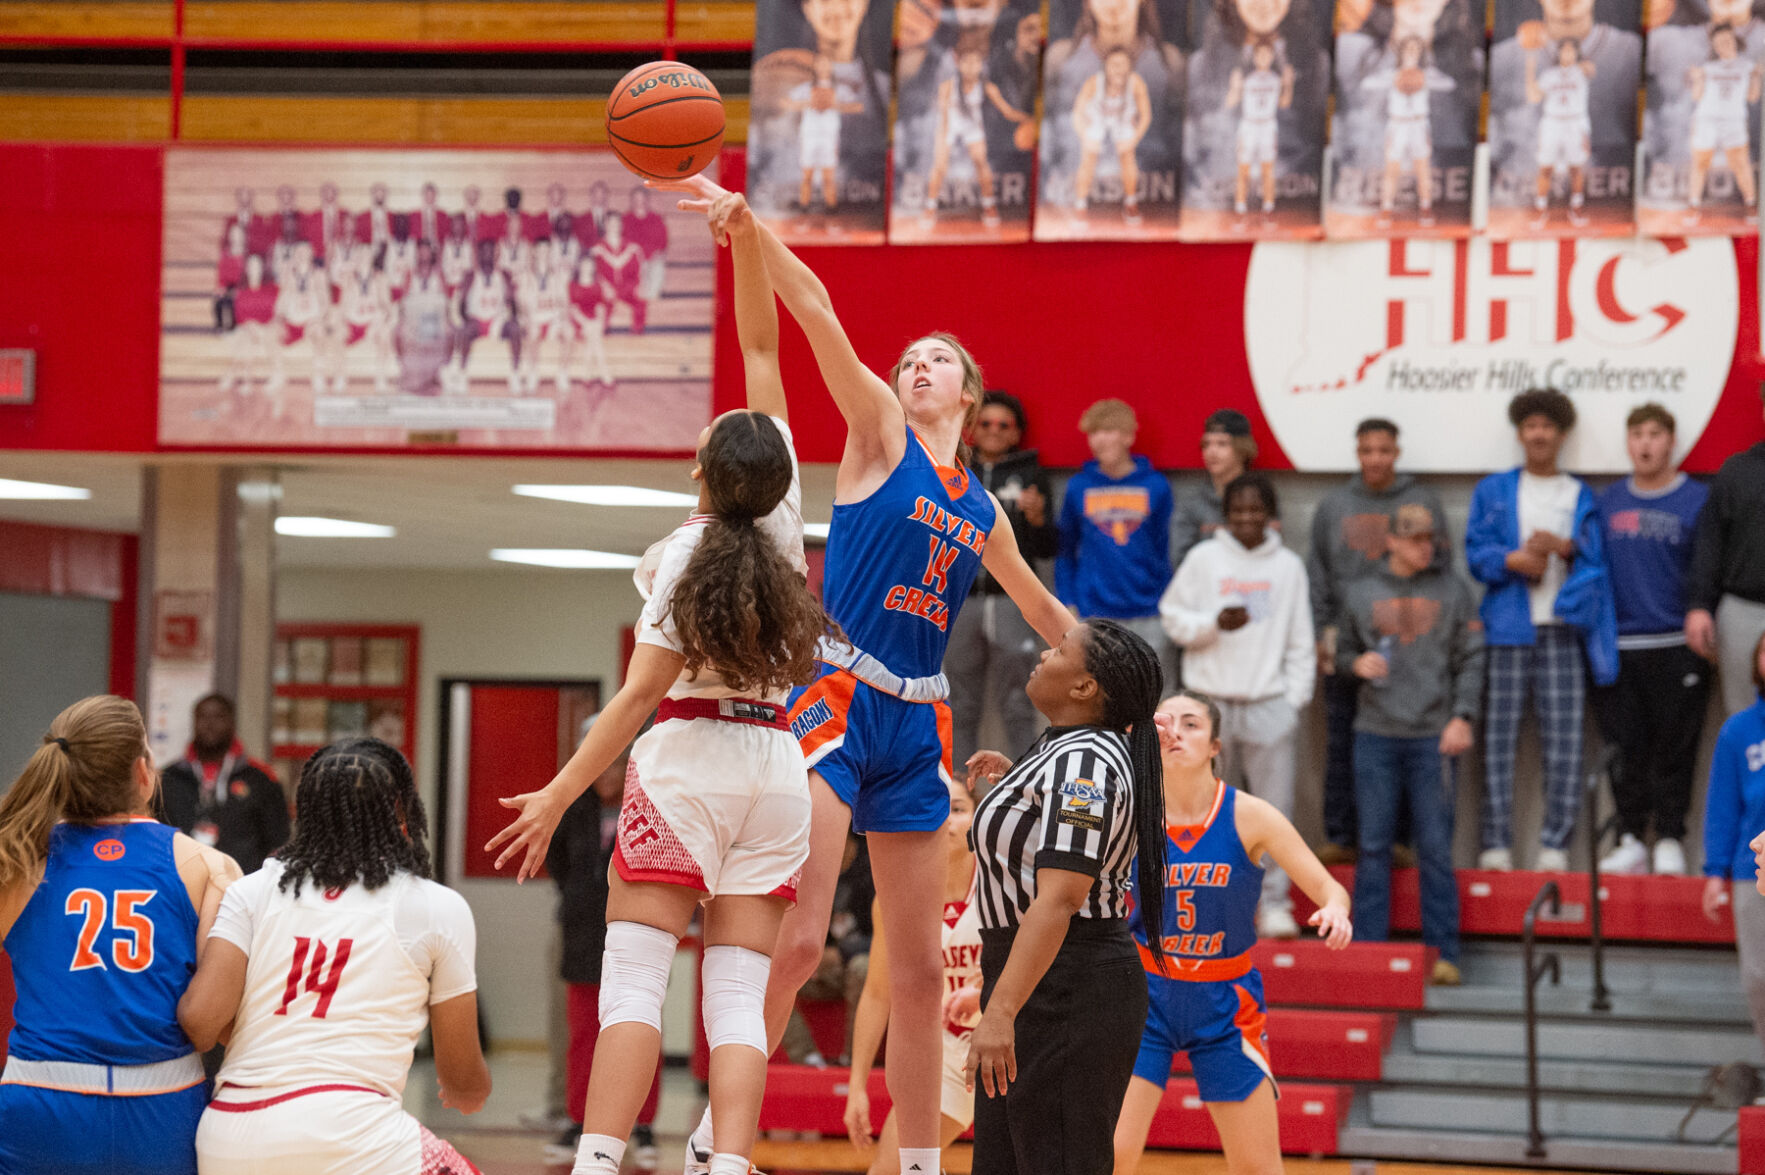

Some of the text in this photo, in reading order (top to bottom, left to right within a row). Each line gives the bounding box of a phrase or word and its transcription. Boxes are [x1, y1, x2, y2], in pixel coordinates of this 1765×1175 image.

[629, 72, 711, 98] Wilson
[901, 172, 1026, 206] BAKR
[1386, 236, 1690, 350] HHC
[1385, 358, 1687, 392] Hoosier Hills Conference
[907, 495, 987, 557] SILVER
[922, 533, 960, 595] 14
[790, 696, 834, 741] RAGONS
[97, 844, 122, 855] CP
[1162, 863, 1232, 888] LVER
[65, 887, 158, 973] 25
[1176, 889, 1197, 932] 5
[1160, 931, 1226, 957] REEK
[273, 936, 354, 1020] 14
